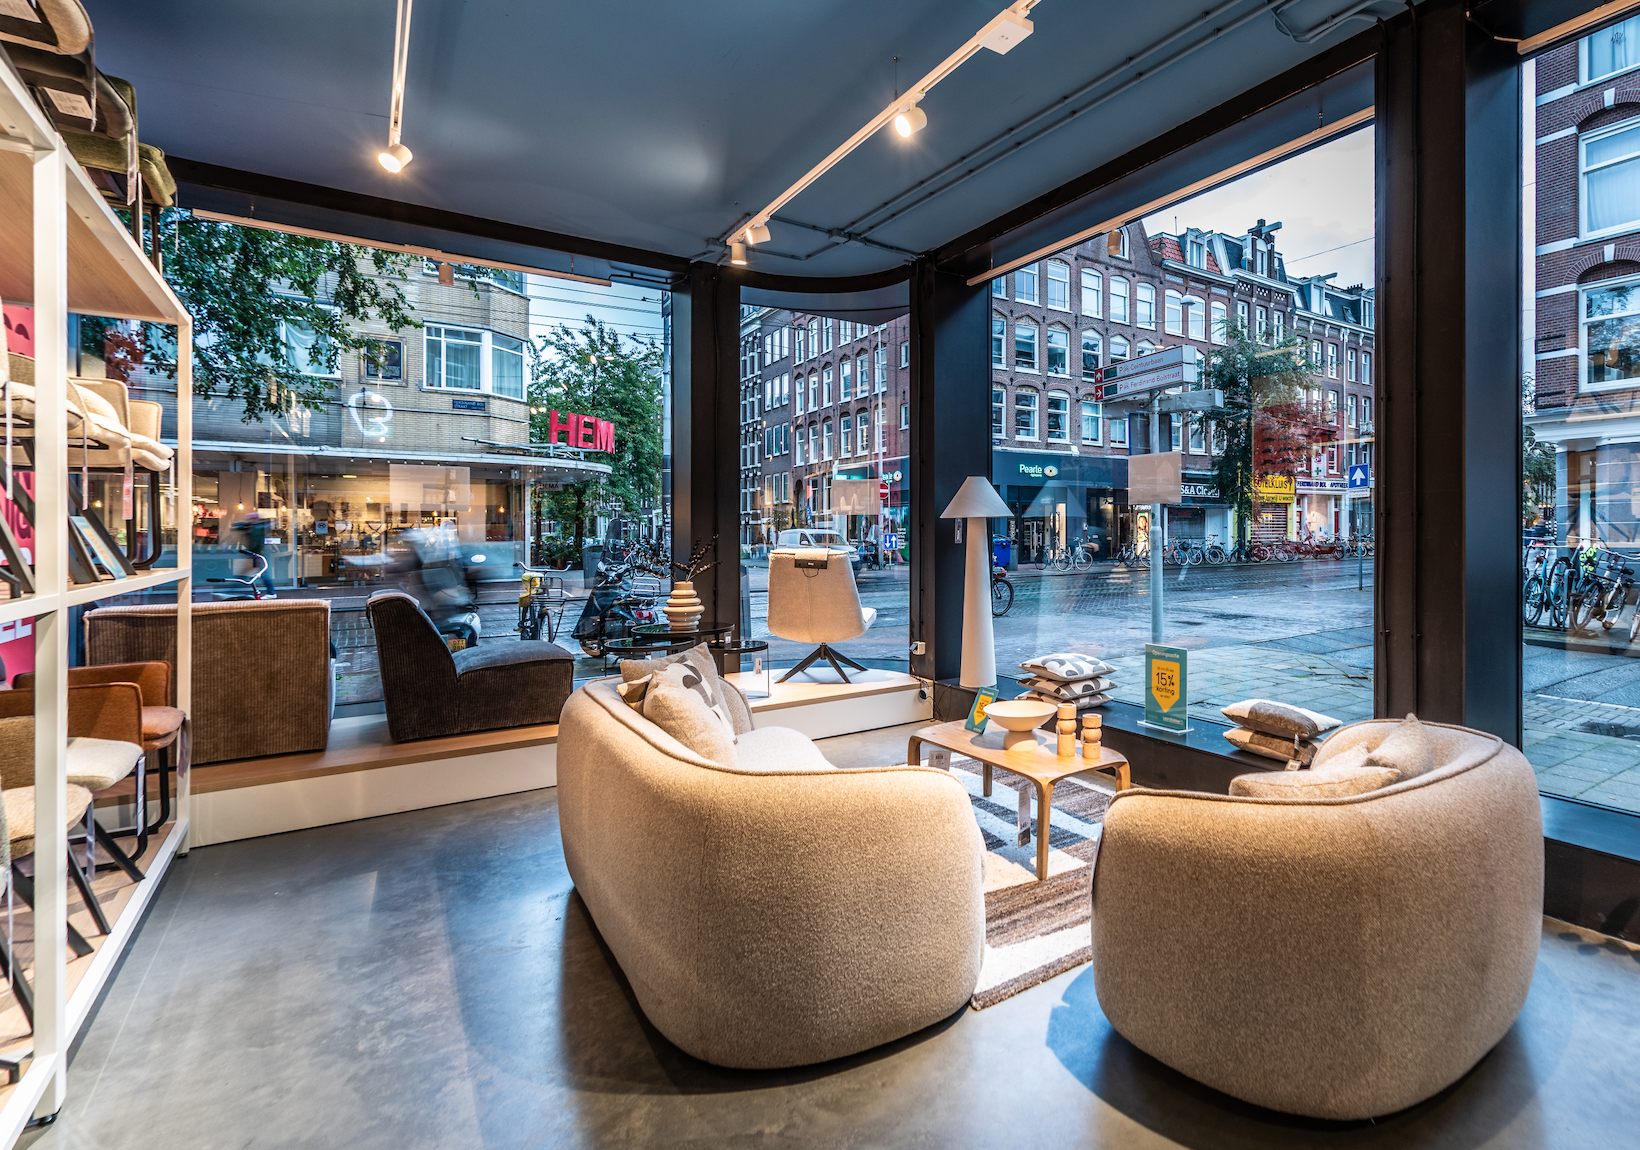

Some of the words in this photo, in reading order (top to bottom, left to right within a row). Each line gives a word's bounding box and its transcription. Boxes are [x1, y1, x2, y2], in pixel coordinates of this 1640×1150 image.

[1130, 357, 1164, 371] Ceintuurbaan
[1130, 377, 1156, 388] Ferdinand
[1156, 371, 1181, 382] Bolstraat
[549, 410, 615, 454] HEM
[1020, 464, 1042, 474] Pearle
[1156, 672, 1175, 687] 15%
[1156, 685, 1175, 696] korting
